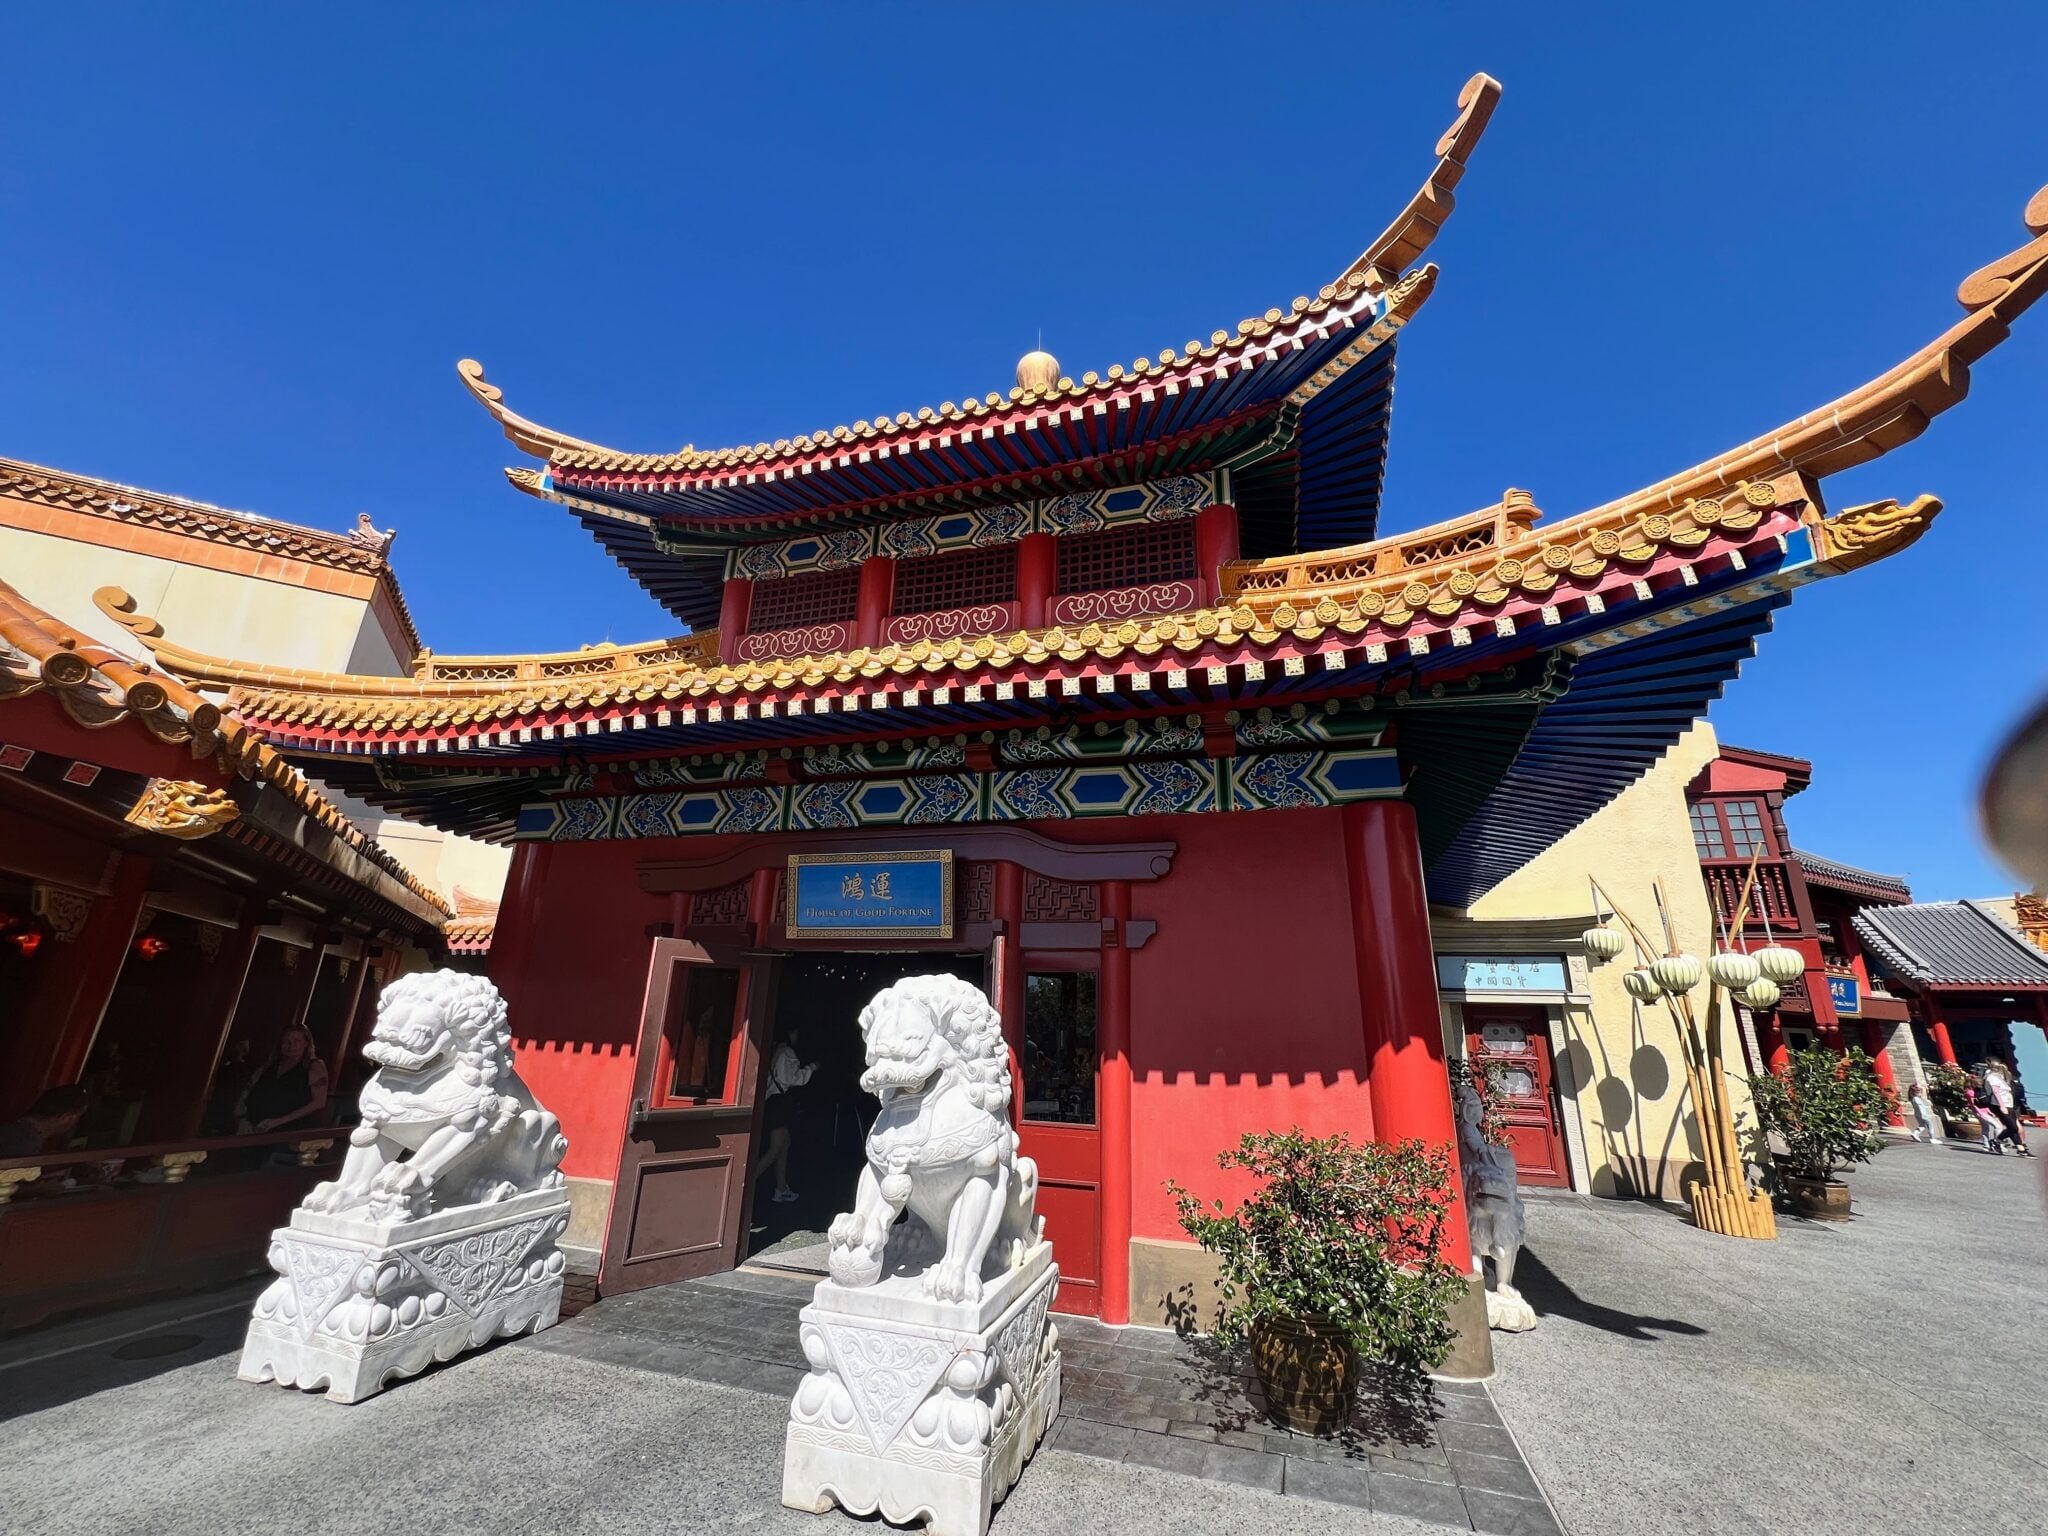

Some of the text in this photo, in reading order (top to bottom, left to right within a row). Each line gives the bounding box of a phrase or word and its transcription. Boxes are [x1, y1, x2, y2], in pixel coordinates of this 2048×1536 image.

[842, 872, 893, 901] 鴻運
[806, 908, 838, 919] HOUSE
[855, 907, 887, 918] GOOD
[889, 906, 933, 917] FORTUNE
